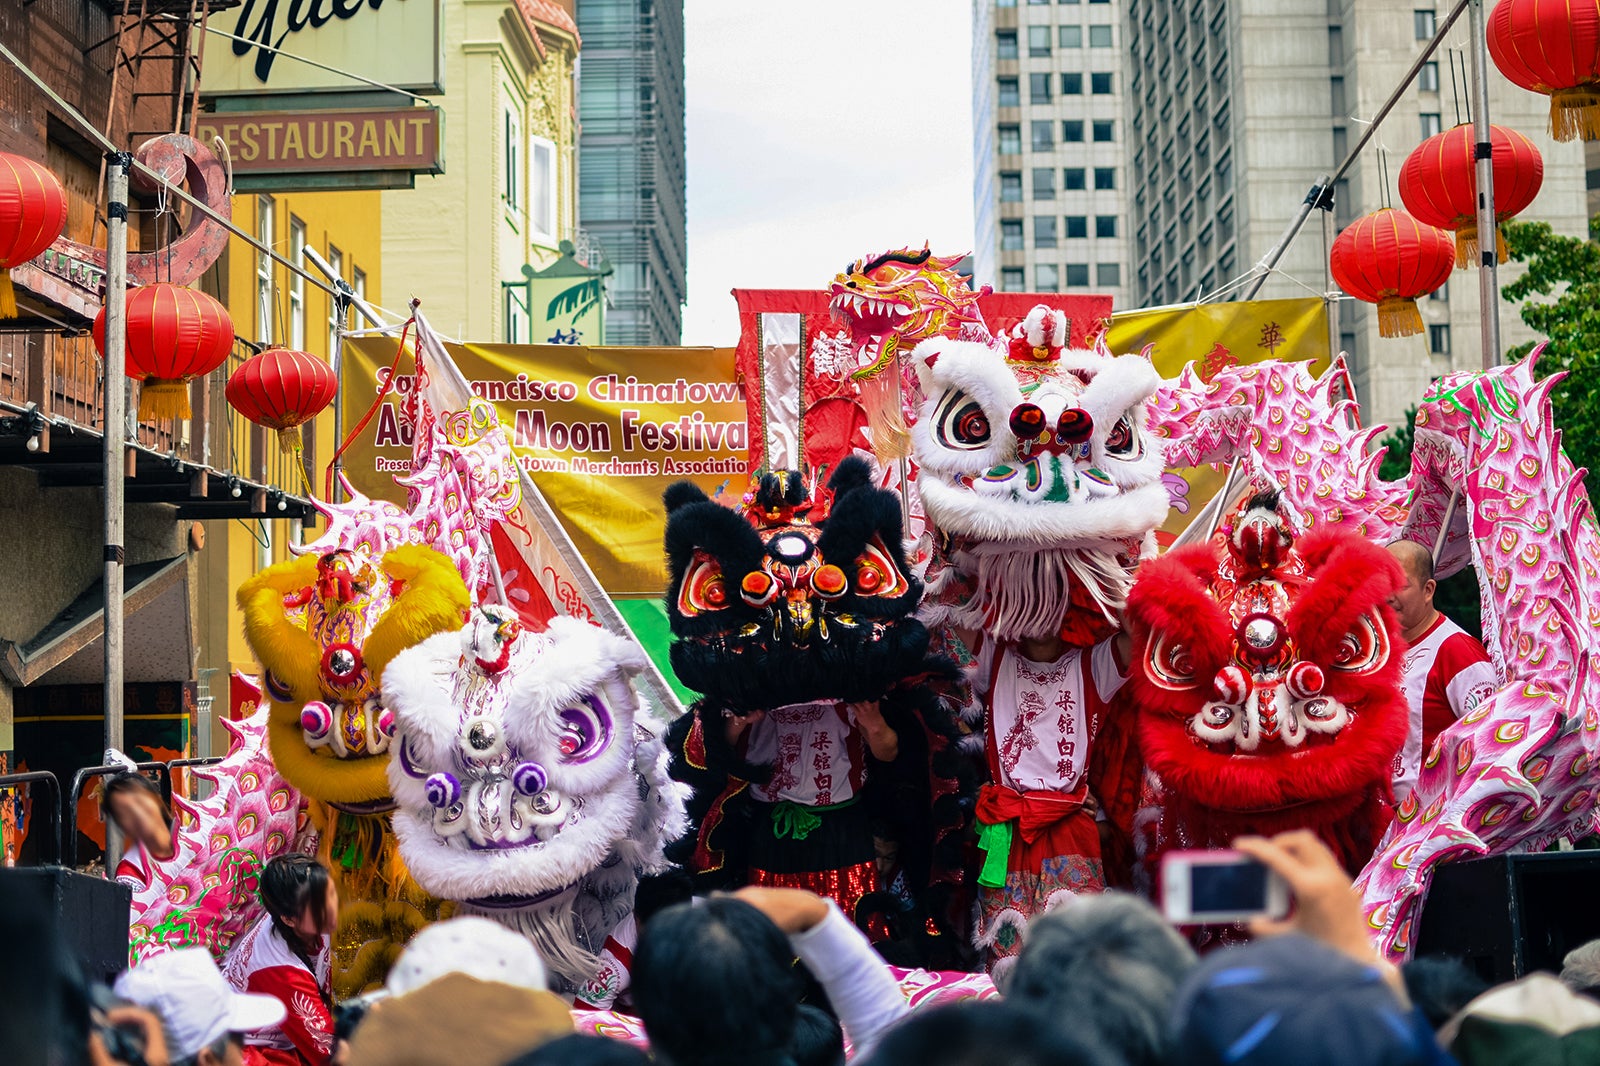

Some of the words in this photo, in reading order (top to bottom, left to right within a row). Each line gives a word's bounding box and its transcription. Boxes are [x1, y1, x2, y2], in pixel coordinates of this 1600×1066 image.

[197, 118, 431, 161] RESTAURANT
[1257, 321, 1286, 355] 華
[376, 366, 417, 396] Sa
[470, 374, 578, 402] ancisco
[514, 409, 611, 452] Moon
[621, 409, 748, 452] Festiva
[571, 456, 659, 476] Merchants
